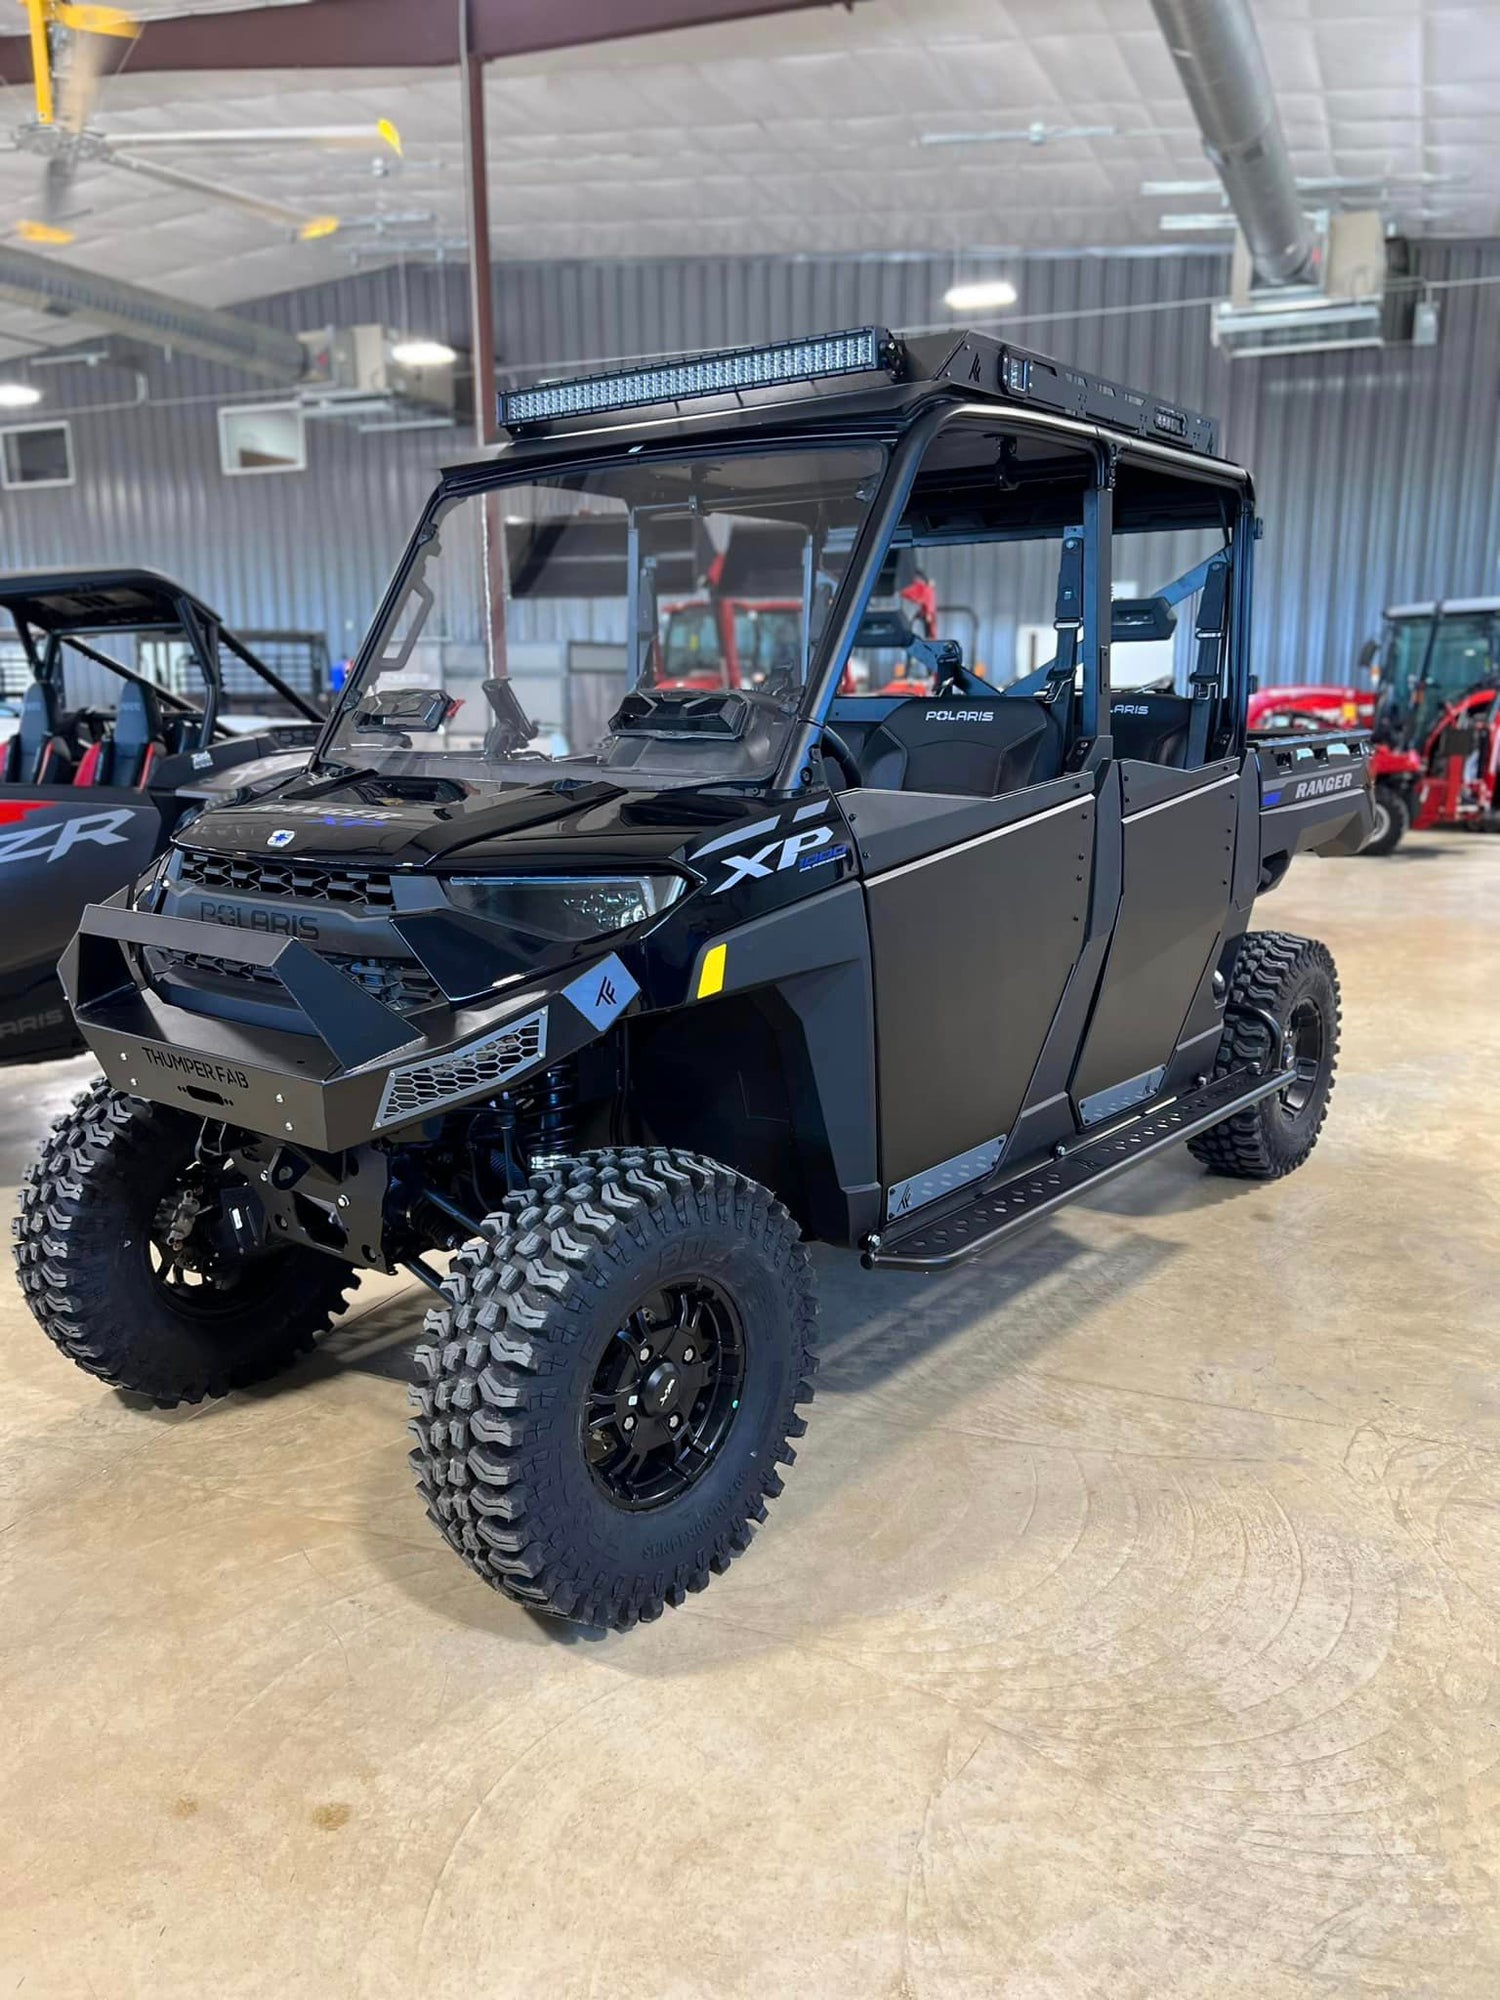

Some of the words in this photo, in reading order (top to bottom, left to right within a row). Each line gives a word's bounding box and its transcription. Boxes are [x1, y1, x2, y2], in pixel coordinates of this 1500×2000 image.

[925, 710, 995, 722] POLARIS
[1110, 704, 1149, 715] ARIS
[1295, 773, 1353, 799] RANGER
[711, 826, 834, 896] XP
[200, 901, 320, 941] POLARIS
[141, 1046, 216, 1081] THUMPER
[215, 1065, 249, 1089] FAB
